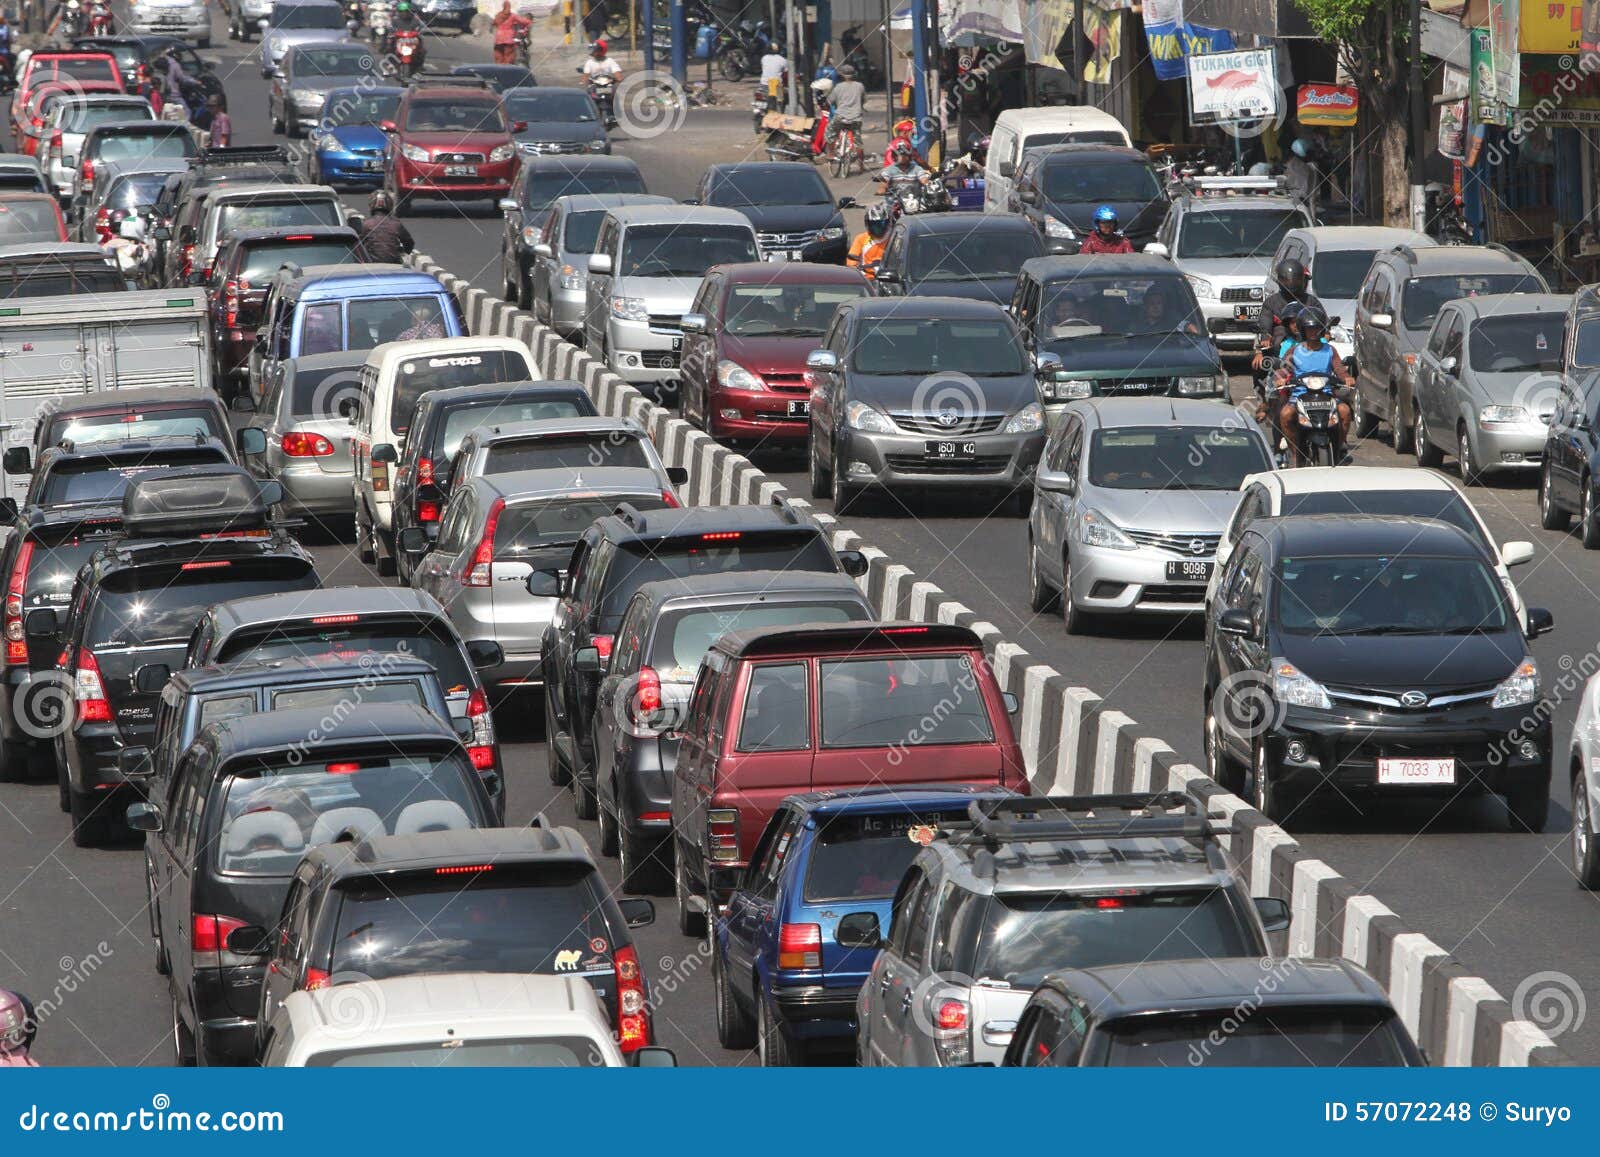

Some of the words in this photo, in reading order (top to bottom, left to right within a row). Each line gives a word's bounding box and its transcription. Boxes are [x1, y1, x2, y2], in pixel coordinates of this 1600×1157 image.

[1195, 56, 1241, 72] TUKANG
[1245, 53, 1268, 68] GIGI
[1168, 562, 1176, 574] H
[1381, 763, 1390, 776] H
[1400, 762, 1429, 776] 7033
[1438, 762, 1453, 776] XY
